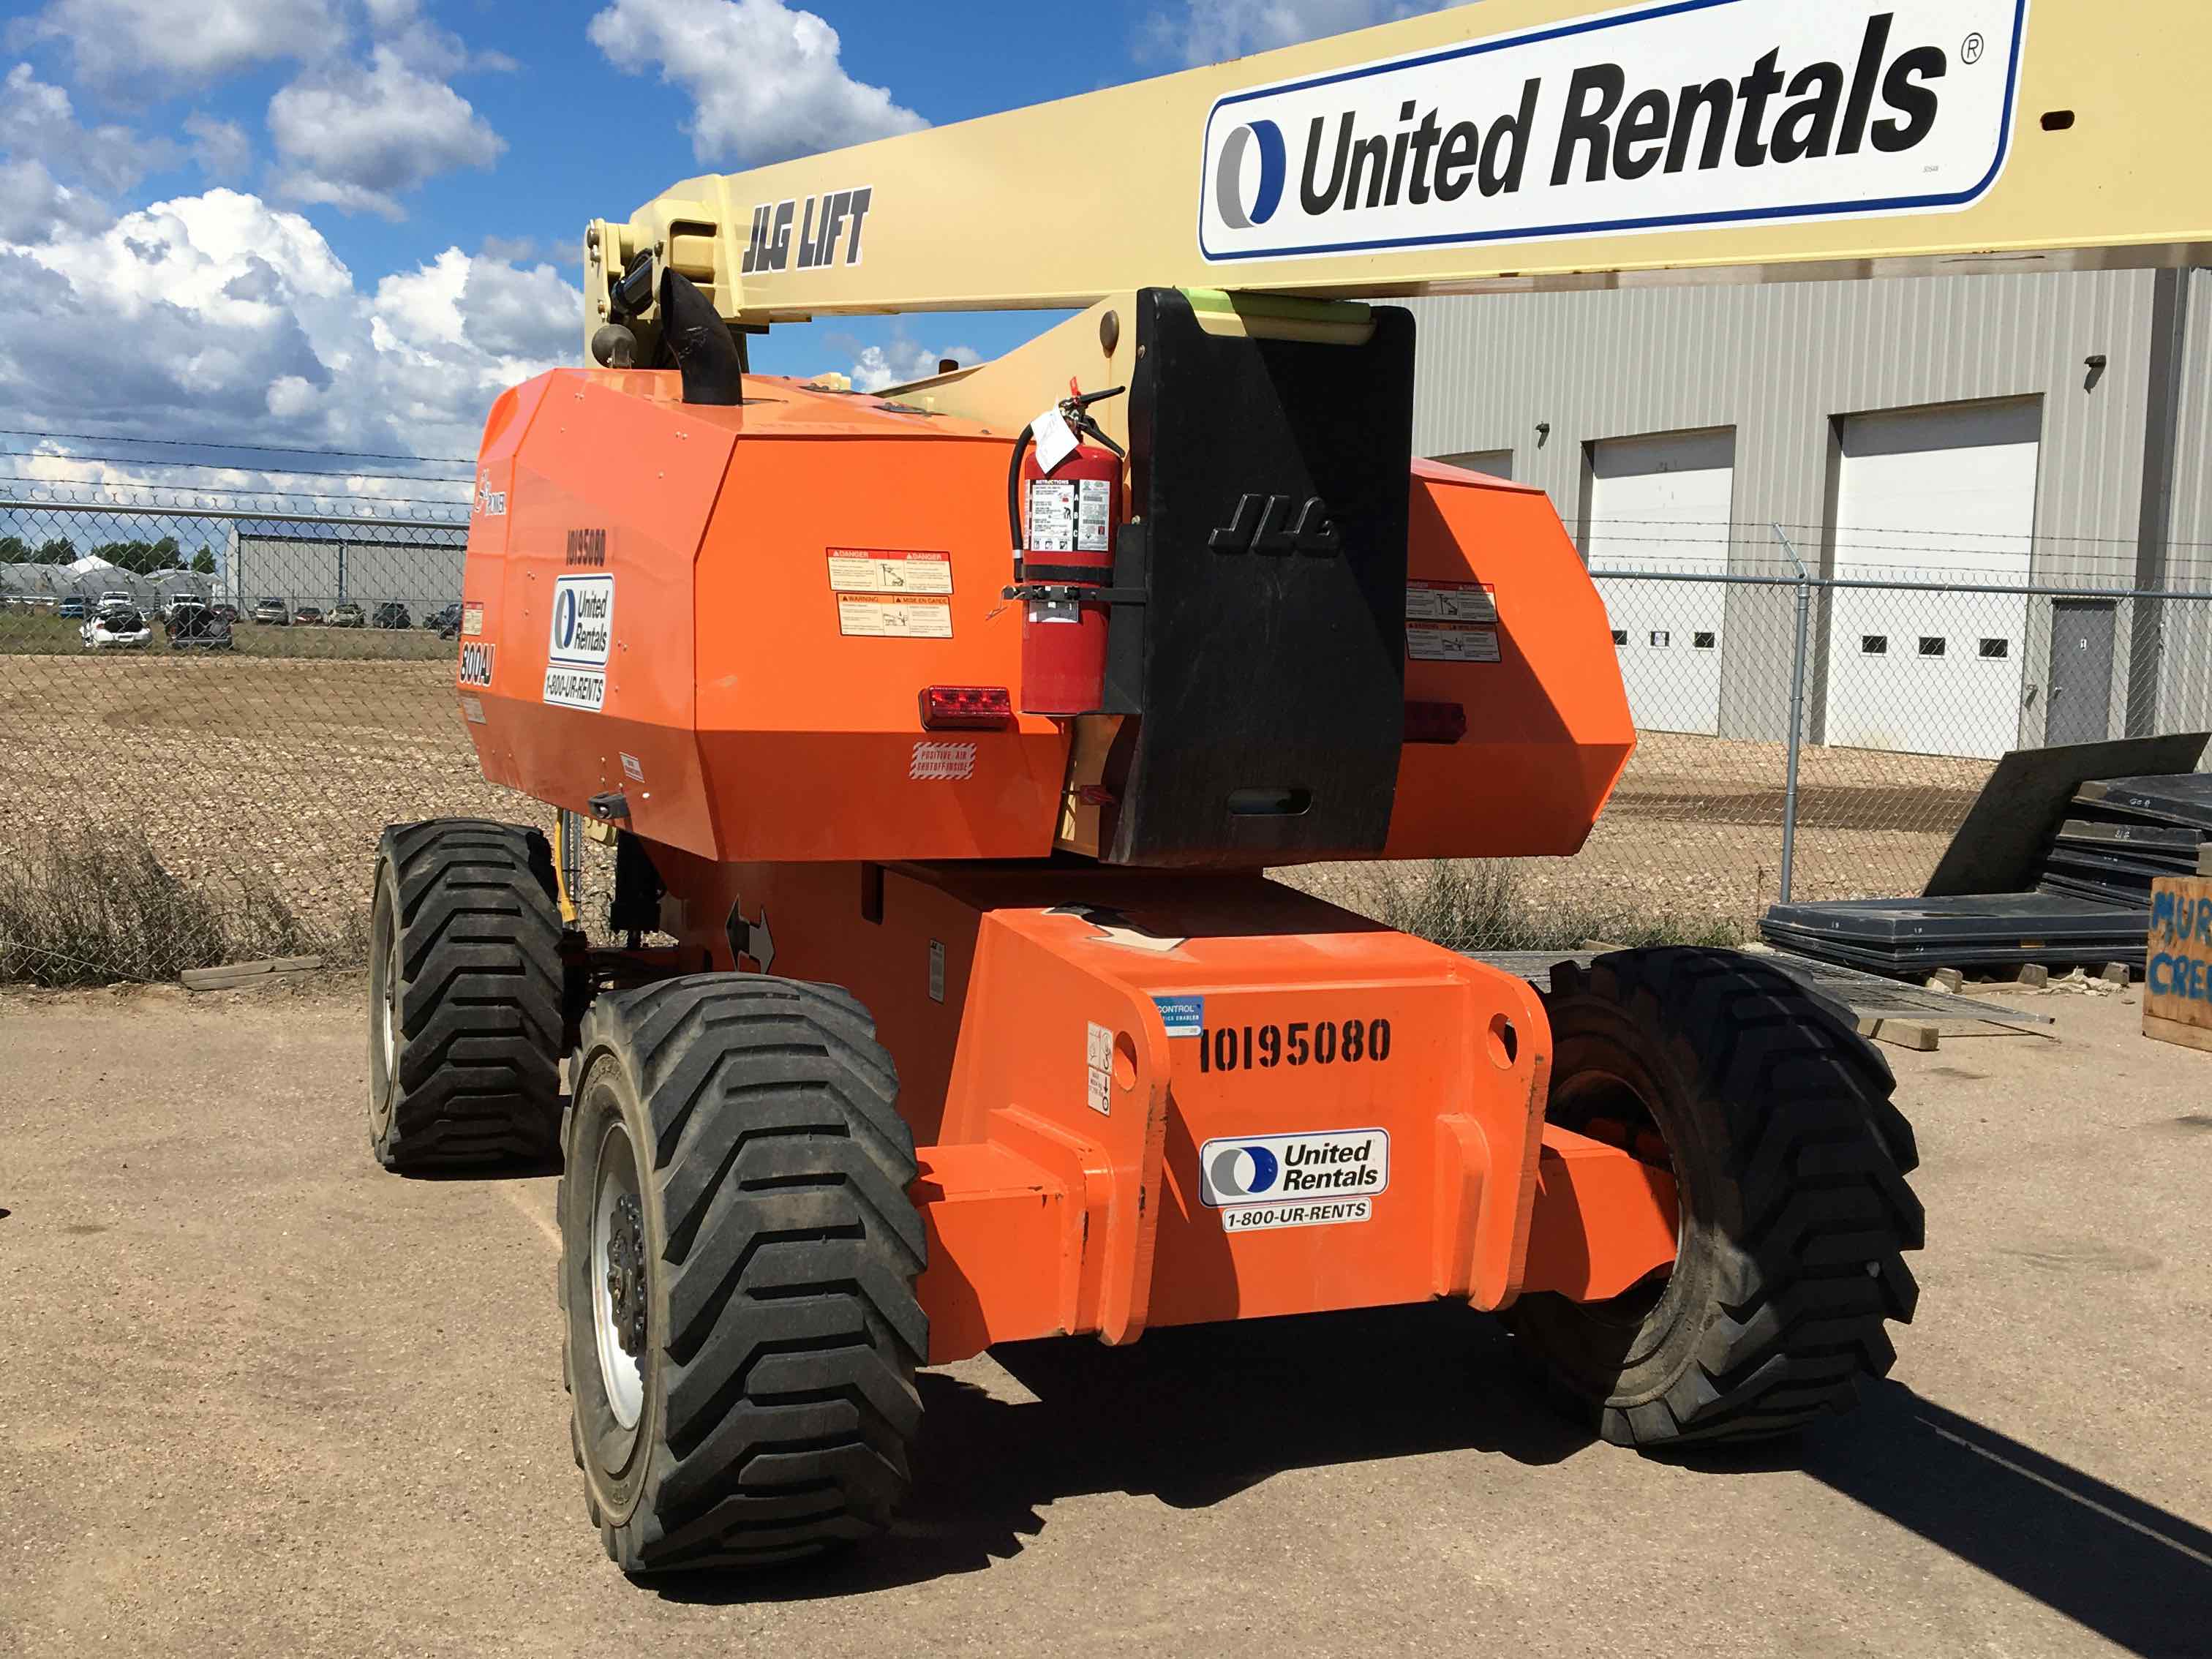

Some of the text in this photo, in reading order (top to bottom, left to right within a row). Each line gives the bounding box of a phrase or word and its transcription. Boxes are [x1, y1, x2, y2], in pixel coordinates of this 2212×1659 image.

[1301, 78, 1541, 215] United
[1549, 12, 1946, 186] Rentals
[742, 187, 872, 274] JLG LIFT
[1208, 494, 1339, 557] JLG
[578, 590, 609, 618] United
[573, 622, 607, 652] Rentals
[460, 643, 495, 685] 800AJ
[546, 674, 603, 702] 1-800-UR-RENTS
[921, 750, 951, 760] POSITIVE
[1200, 1019, 1391, 1073] 10195080
[1284, 1140, 1372, 1167] United
[1282, 1165, 1379, 1192] Rentals
[1228, 1203, 1366, 1227] 1-800-UR-RENTS
